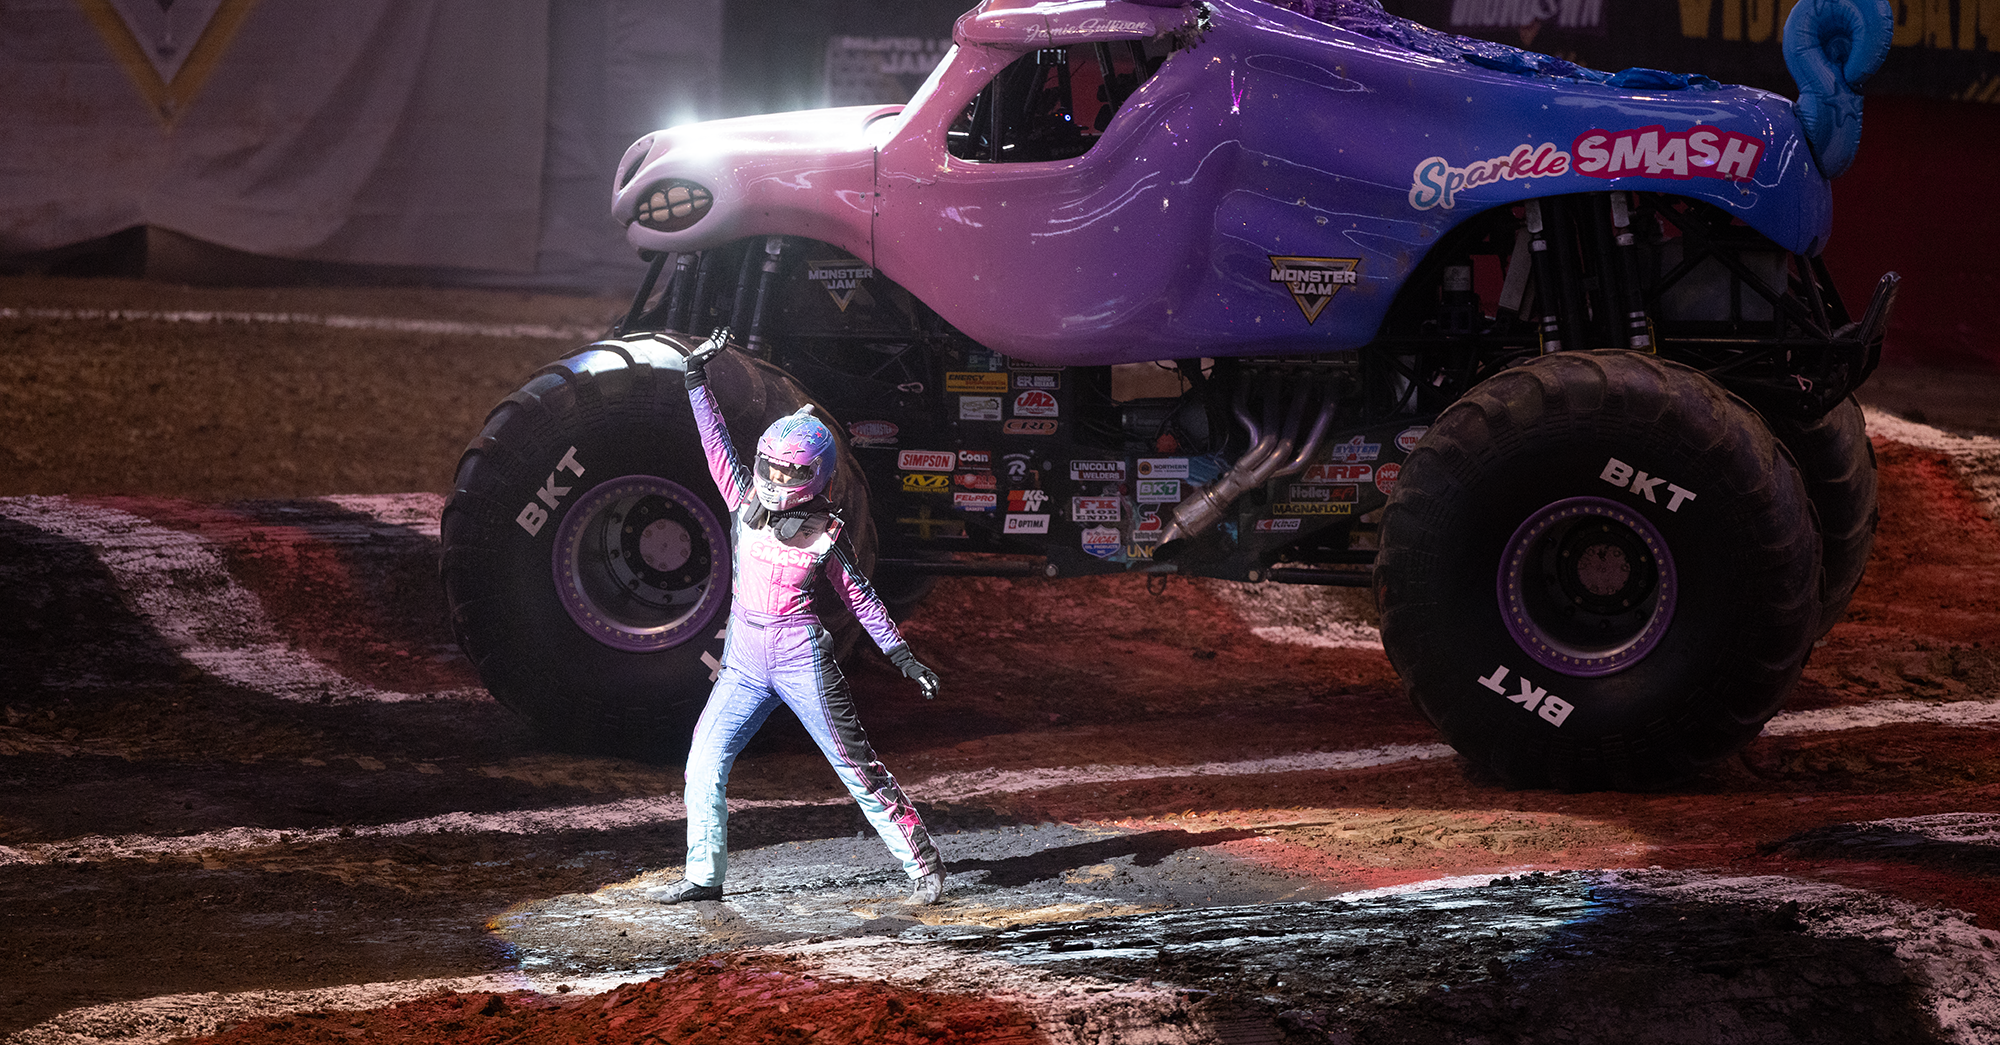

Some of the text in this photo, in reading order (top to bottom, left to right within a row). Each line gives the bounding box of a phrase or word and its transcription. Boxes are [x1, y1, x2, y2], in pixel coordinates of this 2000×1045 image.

[1024, 18, 1148, 43] Jamie Sullivan
[1413, 130, 1760, 208] Sparkle SMASH
[808, 268, 873, 280] MONSTER
[1270, 268, 1357, 284] MONSTER
[827, 279, 856, 289] JAM
[1293, 282, 1332, 295] JAM
[1017, 391, 1054, 407] JAZ
[1335, 445, 1378, 454] SYSTEM
[903, 454, 950, 468] SIMPSON
[960, 451, 988, 462] Coan
[1073, 462, 1116, 471] LINCOLN
[1303, 465, 1371, 479] ARP
[954, 474, 997, 488] WORLD
[1083, 471, 1120, 479] WELDERS
[515, 445, 586, 537] BKT
[1140, 482, 1178, 495] BKT
[1599, 457, 1697, 513] BKT
[1291, 487, 1330, 501] Holley
[1080, 500, 1117, 509] FK
[1273, 504, 1350, 514] MAGNAFLOW
[1018, 520, 1043, 528] OPTIMA
[1273, 520, 1298, 528] KING
[1087, 535, 1117, 544] LUCAS
[750, 541, 813, 569] SMASH
[1477, 664, 1575, 728] BKT
